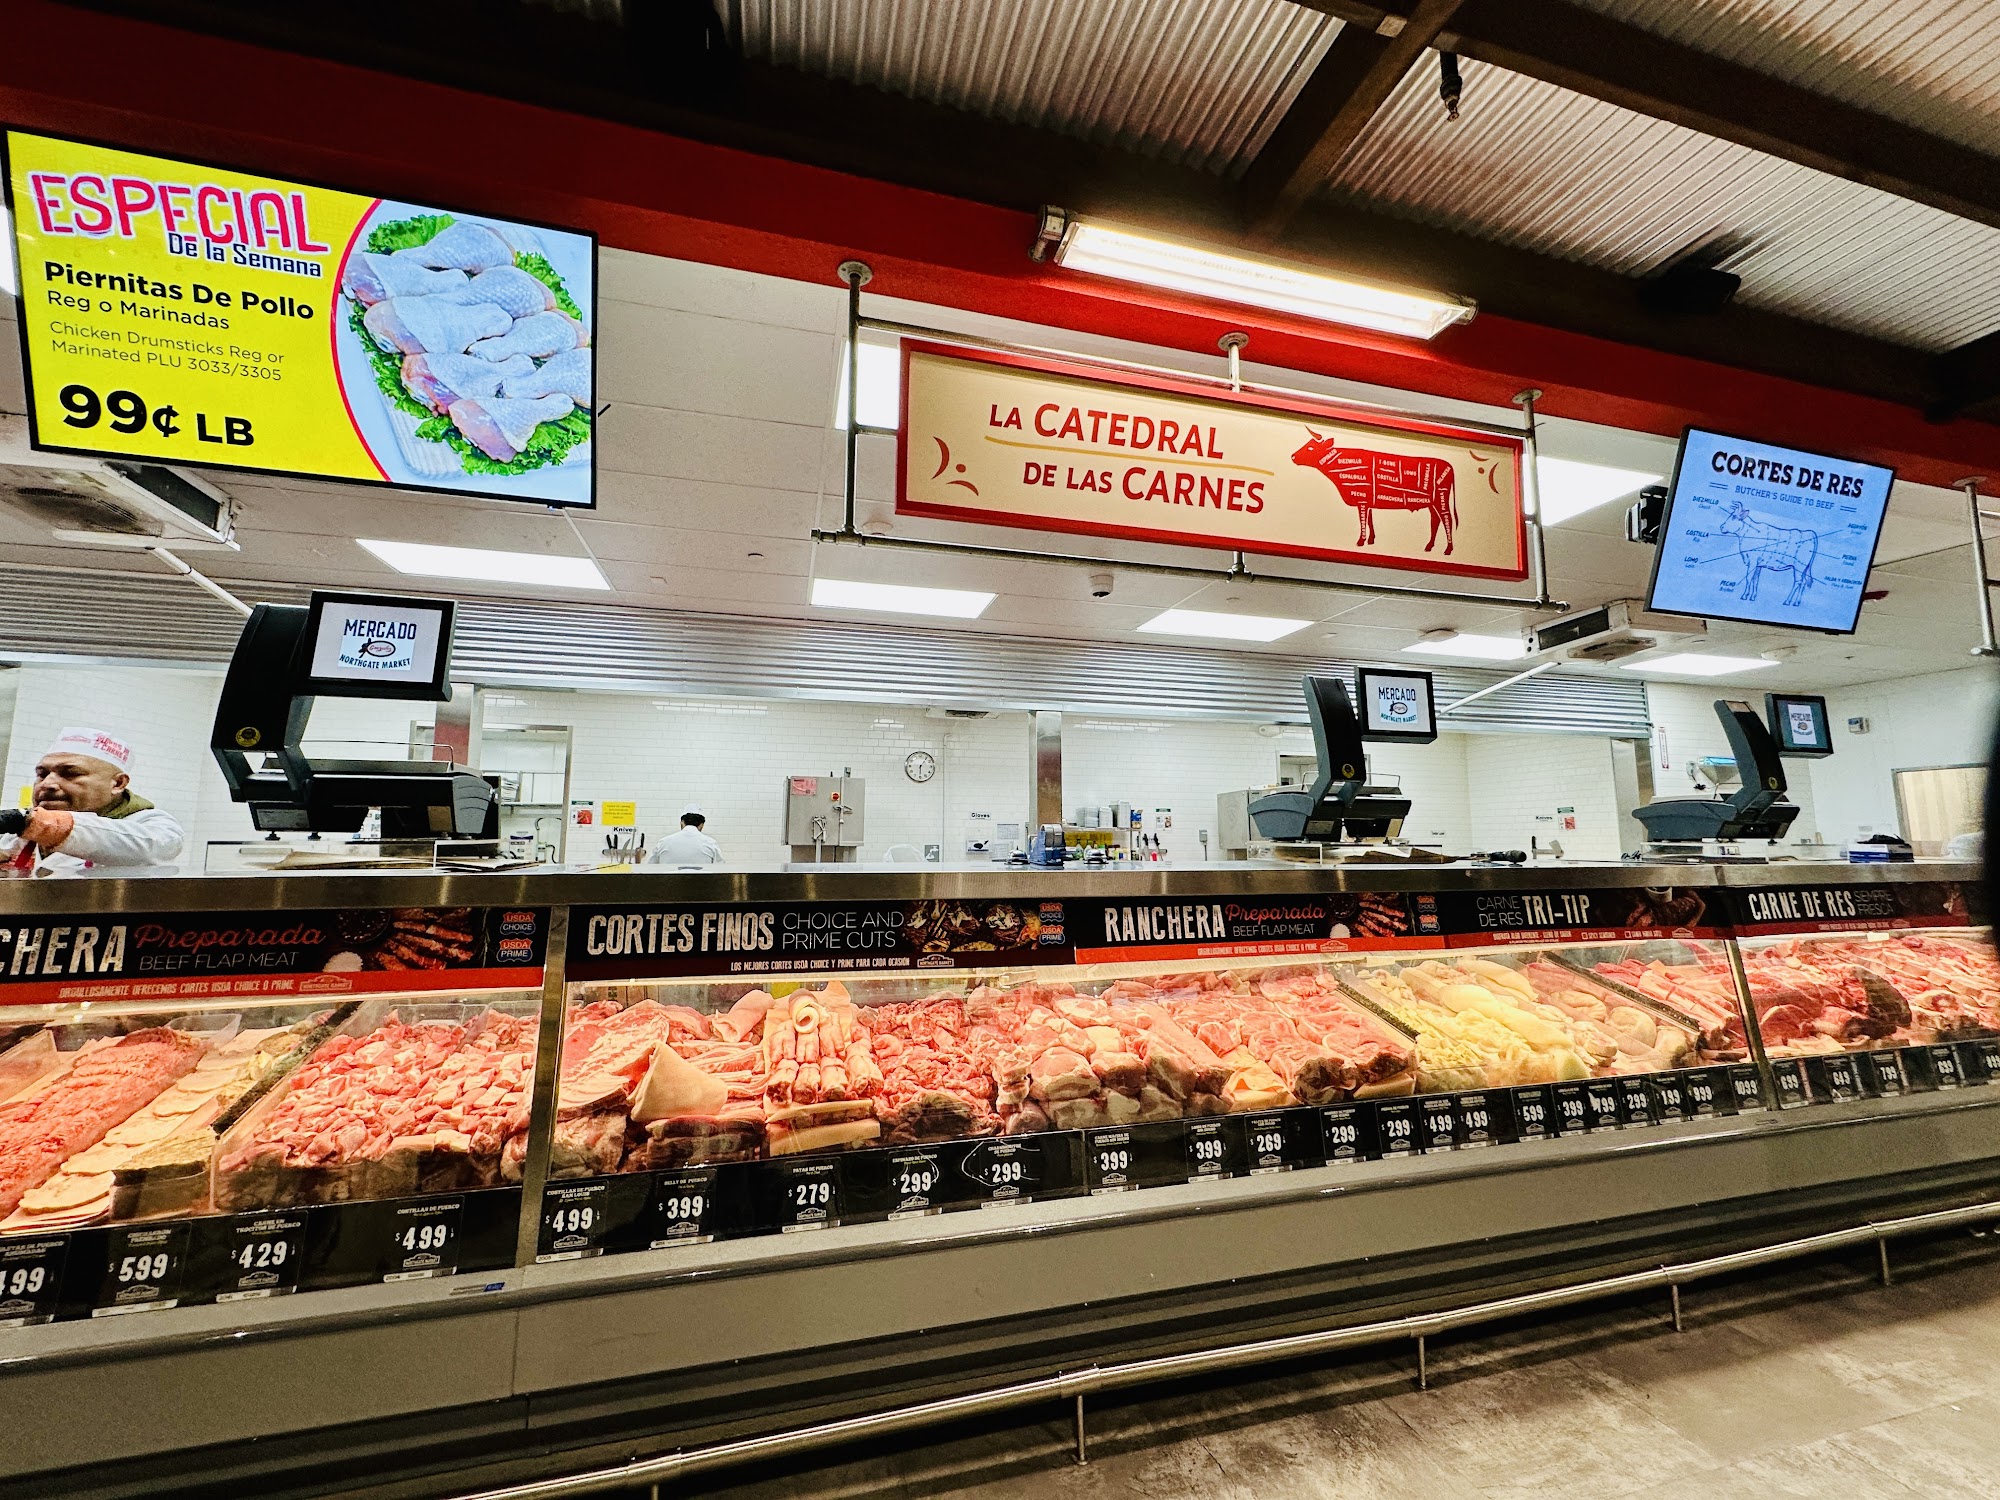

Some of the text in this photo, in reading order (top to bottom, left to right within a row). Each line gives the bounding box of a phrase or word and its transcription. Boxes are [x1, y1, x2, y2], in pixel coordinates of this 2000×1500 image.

[29, 172, 330, 254] ESPECIAL
[169, 233, 321, 277] De la Semana
[45, 261, 314, 319] Piernitas De Pollo
[48, 290, 230, 329] Reg o Marinadas
[50, 321, 285, 364] Chicken Drumsticks Reg or
[52, 340, 282, 381] Marinated PLU 3033/3305
[59, 384, 255, 447] 99¢ LB
[989, 403, 1224, 460] LA CATEDRAL
[1711, 451, 1864, 498] CORTES DE RES
[1023, 461, 1265, 514] DE LAS CARNES
[1735, 485, 1835, 511] BUTCHER'S GUIDE TO BEEF
[1686, 529, 1709, 538] COSTILLA
[344, 619, 417, 640] MERCADO
[339, 654, 411, 669] NORTHGATE MARKET
[1378, 687, 1416, 701] MERCADO
[1476, 896, 1520, 910] CARNE
[1522, 894, 1590, 925] TRI-TIP
[1748, 890, 1856, 921] CARNE DE RES
[1857, 903, 1895, 916] FRESCA
[503, 923, 533, 931] CHOICE
[507, 914, 531, 922] USDA
[782, 910, 905, 930] CHOICE AND
[1104, 903, 1327, 942] RANCHERA Preparada
[1479, 912, 1523, 927] DE RES
[134, 923, 326, 954] Preparada
[587, 912, 775, 956] CORTES FINOS
[782, 930, 896, 950] PRIME CUTS
[1233, 923, 1315, 937] BEEF FLAP MEAT
[503, 941, 528, 949] USDA
[140, 951, 299, 971] BEEF FLAP MEAT
[730, 961, 742, 971] LOS
[744, 961, 769, 971] MEJORES
[771, 960, 792, 970] CORTES
[794, 960, 808, 969] USDA
[810, 959, 829, 969] CHOICE
[837, 959, 854, 968] PRIME
[856, 958, 871, 967] PARA
[872, 958, 887, 967] CADA
[132, 983, 177, 996] OFRECEMOS
[180, 982, 208, 994] CORTES
[211, 981, 231, 992] USDA
[234, 980, 260, 991] CHOICE
[271, 979, 294, 990] PRIME
